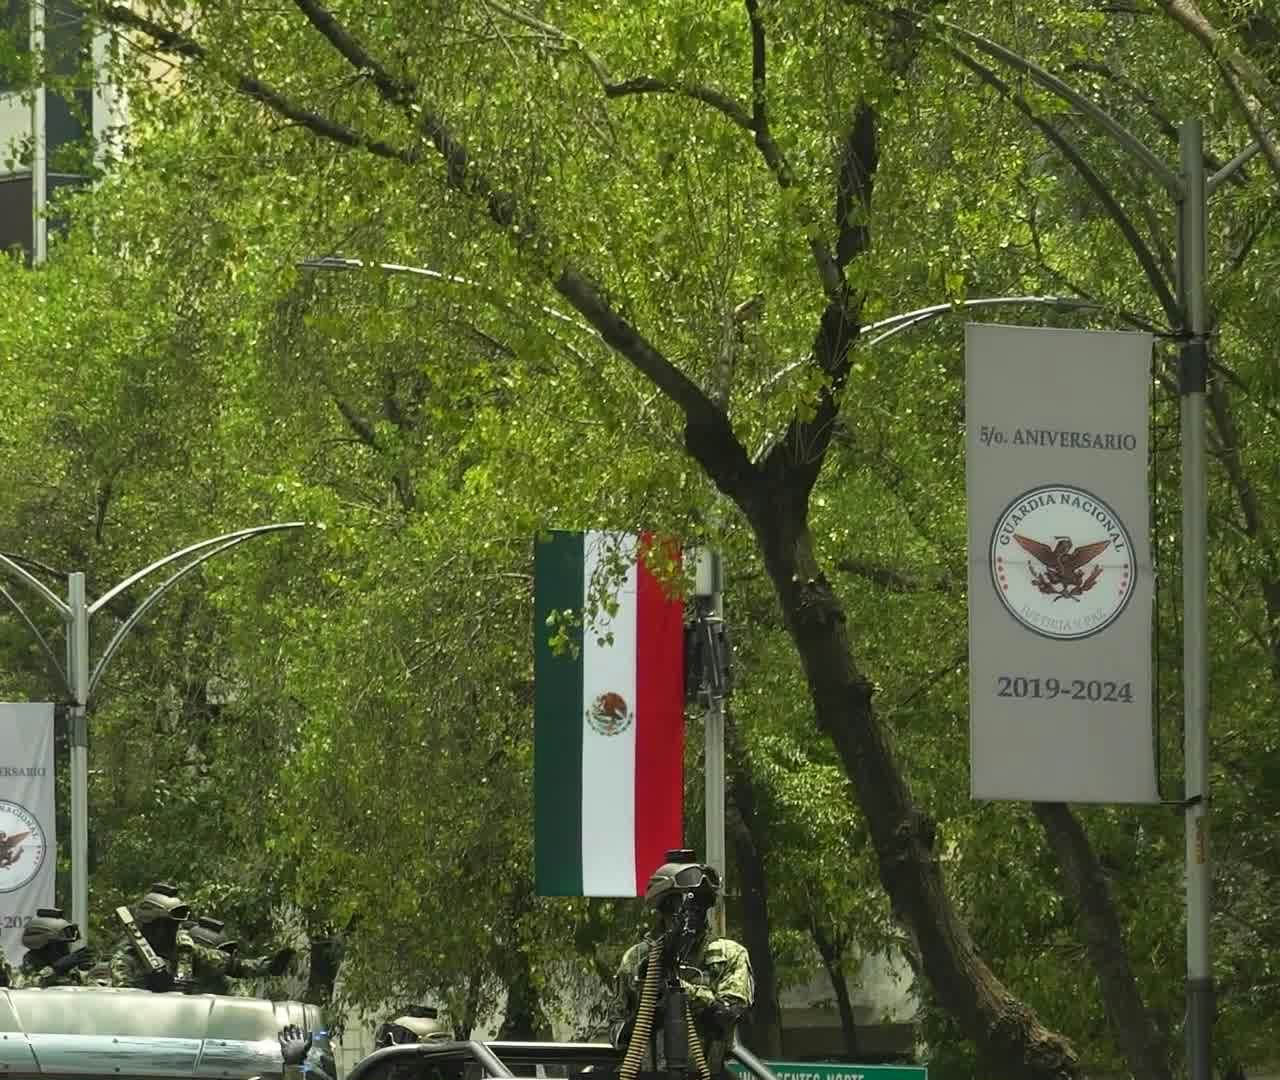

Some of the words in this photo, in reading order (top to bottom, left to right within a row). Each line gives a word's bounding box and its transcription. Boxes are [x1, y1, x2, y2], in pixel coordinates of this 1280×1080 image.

[1012, 428, 1137, 451] ANIVERSARIO
[999, 494, 1057, 547] GUARDIA
[1060, 493, 1125, 553] NACIONAL
[997, 676, 1134, 704] 2019-2024
